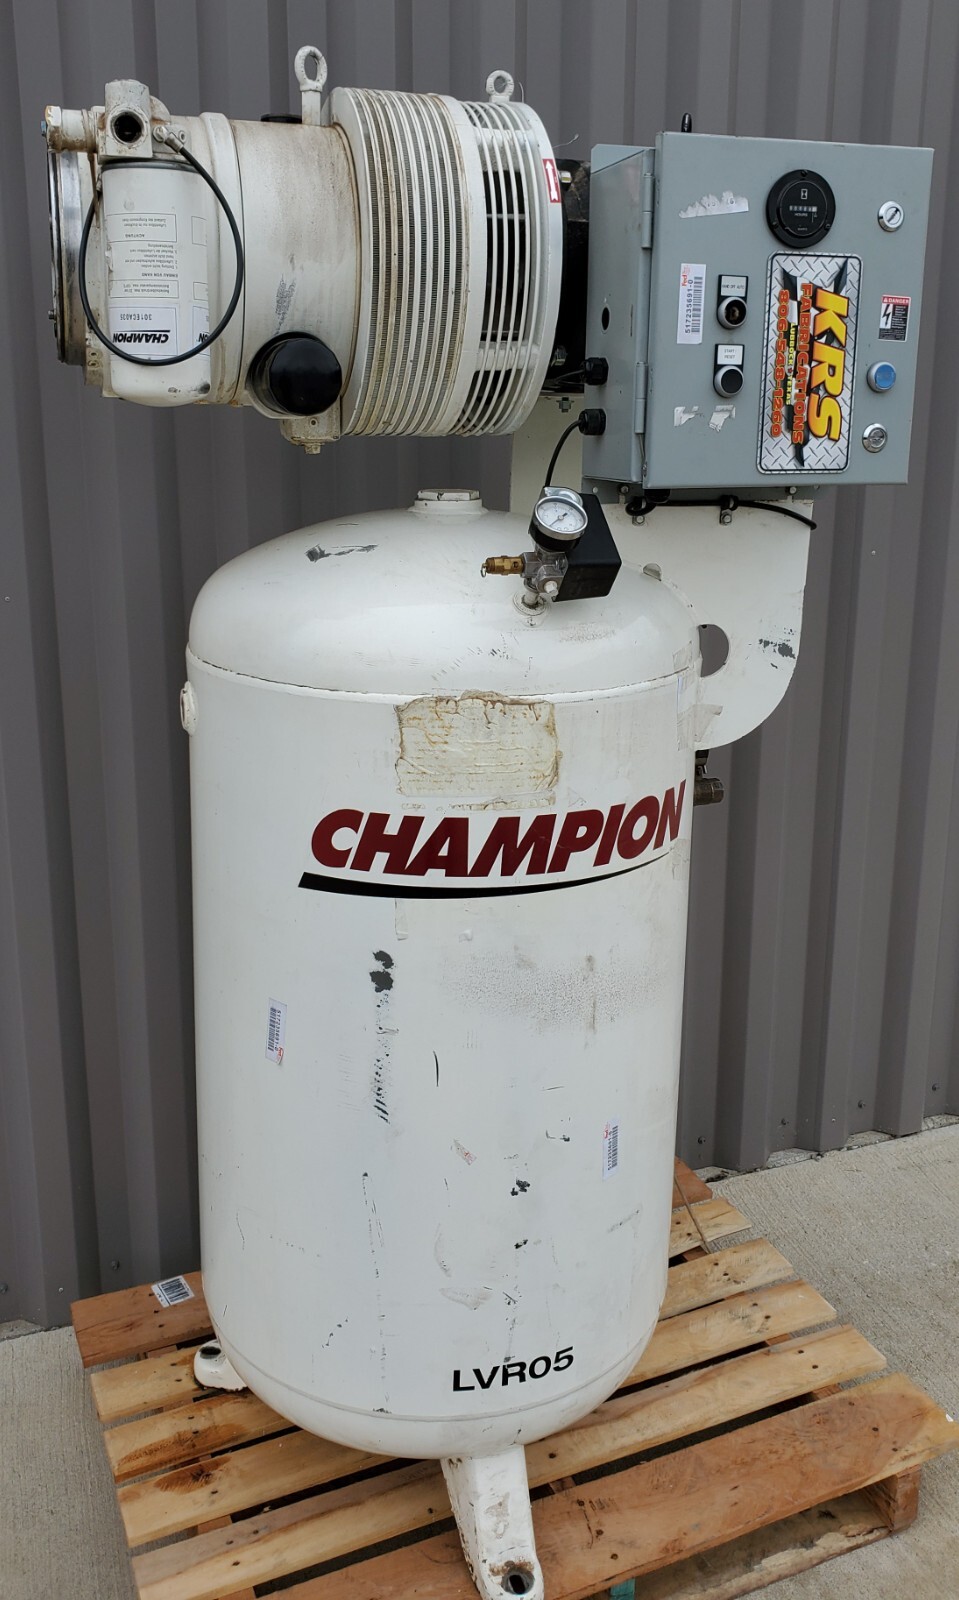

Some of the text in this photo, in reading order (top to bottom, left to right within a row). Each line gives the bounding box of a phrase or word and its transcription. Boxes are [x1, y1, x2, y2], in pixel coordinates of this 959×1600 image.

[113, 333, 169, 343] CHAMPION
[685, 279, 694, 334] 517235691-0
[770, 288, 791, 438] 806-548-1260
[785, 322, 796, 406] LUBBOCK TEXAS
[790, 282, 813, 444] FABRICATIONS
[807, 288, 849, 442] KRS
[310, 779, 687, 878] CHAMPION
[452, 1345, 574, 1392] LVR05
